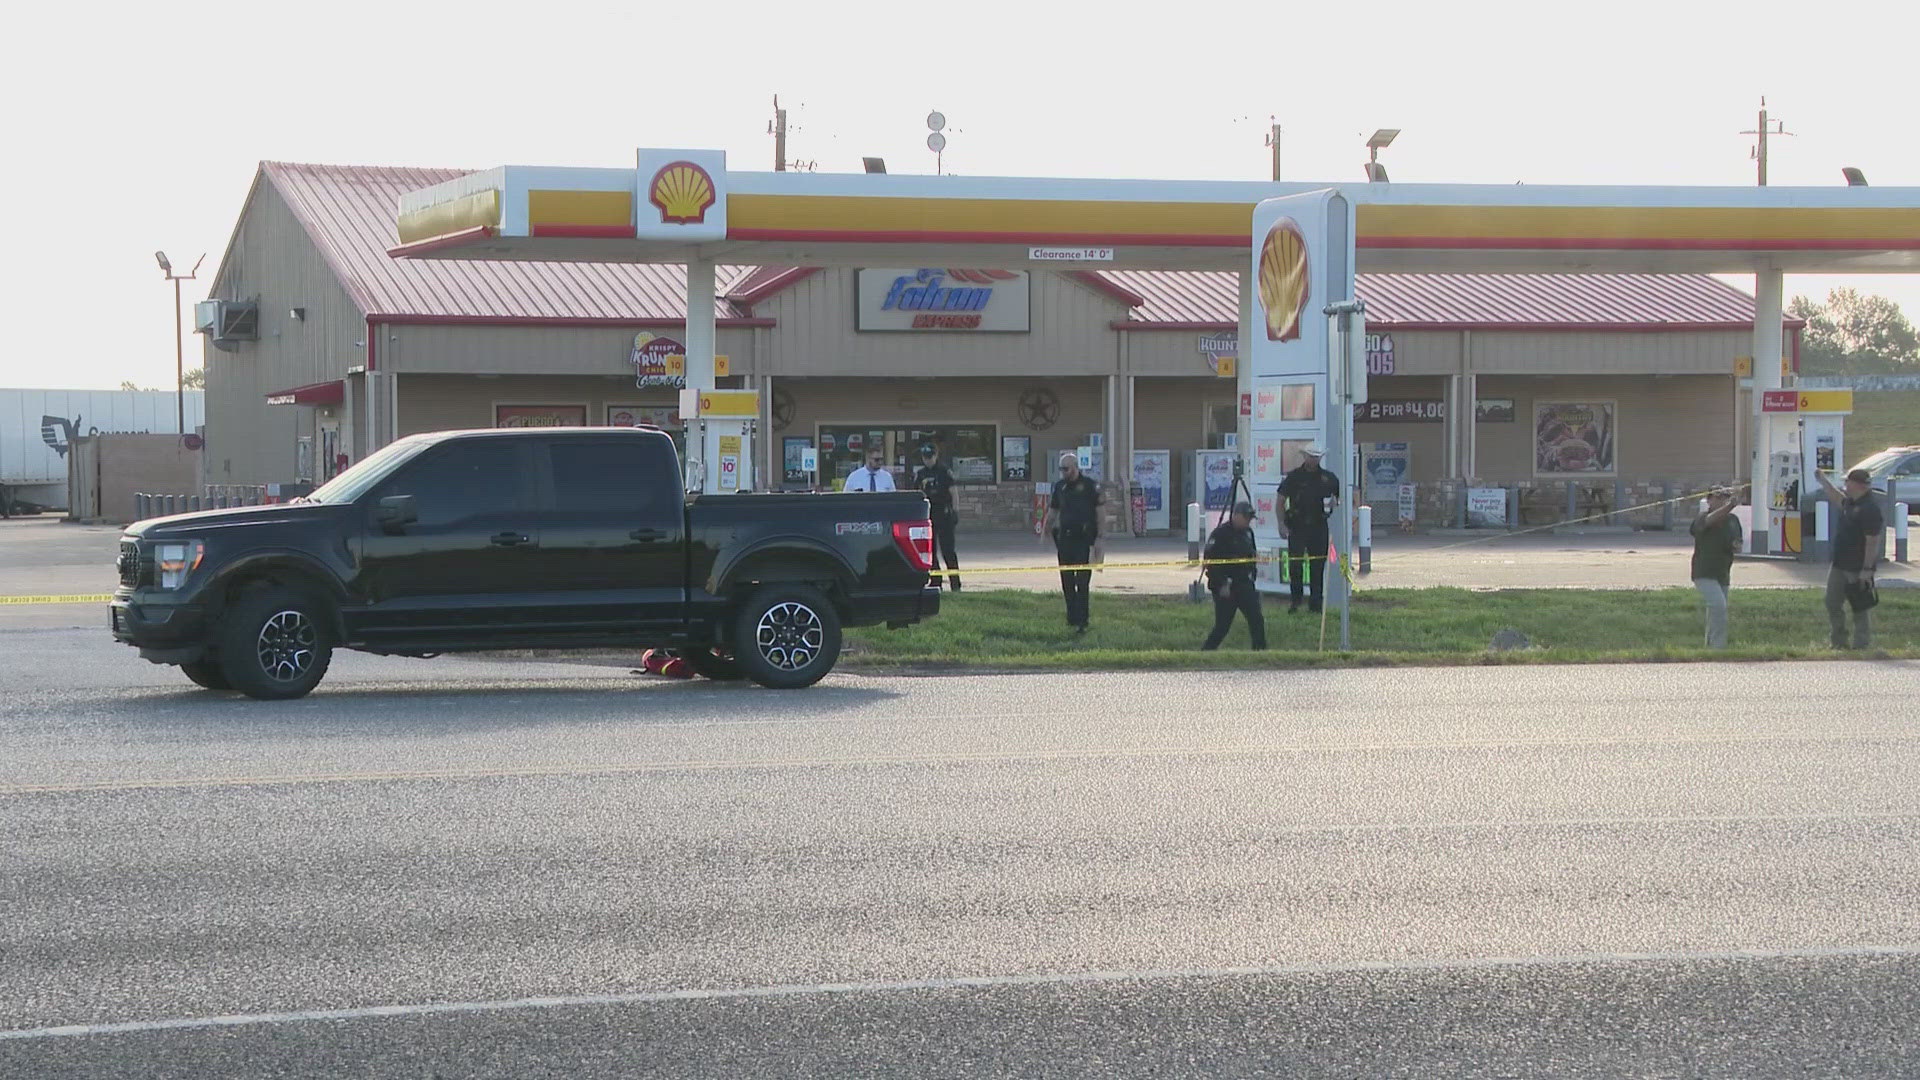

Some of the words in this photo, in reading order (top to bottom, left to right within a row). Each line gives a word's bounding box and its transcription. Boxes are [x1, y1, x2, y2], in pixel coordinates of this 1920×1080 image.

[1033, 249, 1081, 258] Clearance
[911, 314, 982, 328] EXPRESS
[648, 344, 677, 352] KRISPY
[670, 361, 681, 370] 10
[700, 398, 711, 410] 10
[1800, 397, 1808, 408] 6
[1370, 403, 1380, 418] 2
[1382, 404, 1403, 416] FOR
[1405, 402, 1444, 418] $4.00
[836, 522, 882, 535] FX4
